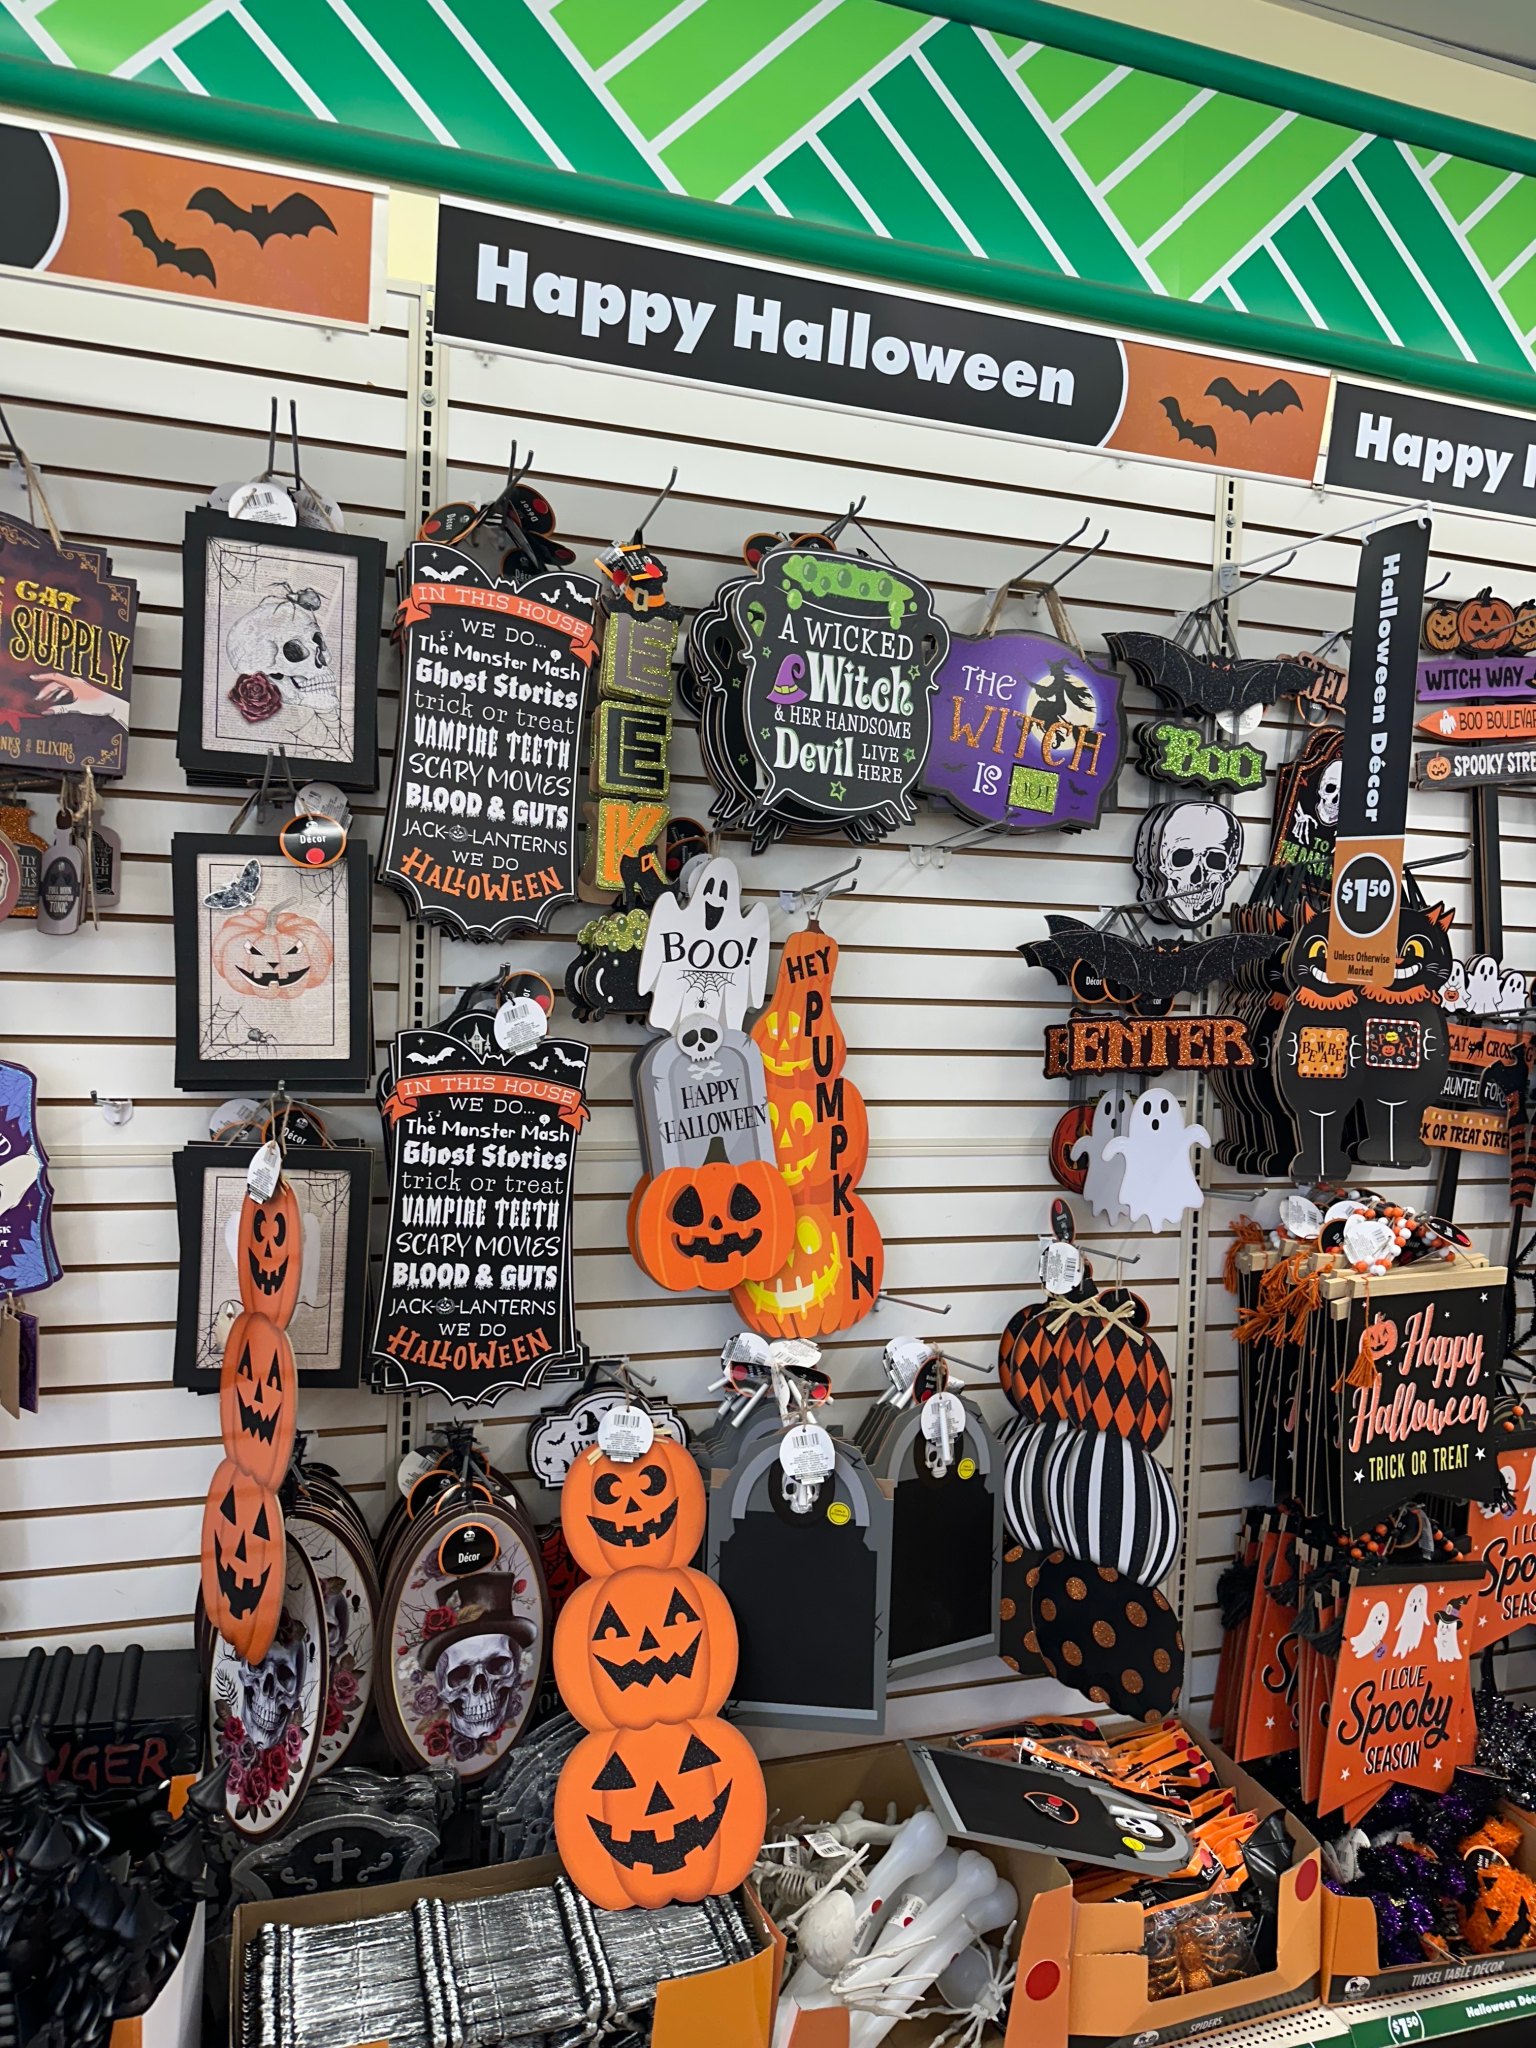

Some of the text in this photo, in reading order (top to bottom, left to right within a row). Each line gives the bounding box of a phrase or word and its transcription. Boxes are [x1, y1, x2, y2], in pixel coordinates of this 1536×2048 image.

[476, 243, 1076, 406] Happy Halloween
[1355, 412, 1514, 493] Happy
[515, 568, 533, 581] Déco
[418, 586, 588, 637] IN THIS HOUSE
[10, 604, 131, 691] SUPPLY
[461, 618, 546, 648] WE DO...
[778, 613, 914, 662] A WICKED
[419, 634, 581, 681] The Monster Mash
[415, 657, 578, 710] Ghost Stories
[806, 650, 914, 716] Witch
[961, 665, 1017, 700] THE
[1365, 553, 1400, 823] Halloween Décor
[1425, 666, 1524, 691] WITCH WAY
[414, 690, 575, 735] trick or treat
[774, 705, 912, 740] & HER HANDSOME
[1459, 712, 1482, 730] BOO
[414, 713, 570, 771] VAMPIRE TEETH
[773, 726, 855, 778] Devil
[949, 695, 1107, 777] WITCH
[861, 743, 900, 764] LIVE
[1454, 753, 1504, 777] SPOOKY
[409, 753, 572, 797] SCARY MOVIES
[857, 763, 903, 785] HERE
[973, 761, 1003, 796] IS
[405, 782, 569, 831] BLOOD & GUTS
[300, 834, 326, 844] Décor
[1313, 837, 1330, 852] TO
[400, 847, 564, 902] HALLOWEEN
[452, 850, 519, 871] WE DO
[660, 931, 758, 969] BOO!
[785, 946, 834, 984] HEY
[1334, 951, 1390, 964] Unless Otherwise
[1086, 976, 1102, 986] Décor
[1348, 965, 1373, 976] Marked
[1070, 1020, 1255, 1072] ENTER
[1302, 1041, 1344, 1063] BEWARE
[1449, 1034, 1468, 1052] CAT
[404, 1076, 576, 1105] IN THIS HOUSE
[680, 1077, 740, 1110] HAPPY
[1443, 1076, 1480, 1099] AUNTED
[449, 1097, 535, 1115] WE DO...
[406, 1117, 570, 1142] The Monster Mash
[664, 1105, 767, 1144] HALLOWEEN
[1433, 1124, 1447, 1141] OR
[1450, 1126, 1481, 1145] TREAT
[403, 1140, 568, 1171] Ghost Stories
[401, 1168, 564, 1195] trick or treat
[401, 1193, 560, 1232] VAMPIRE TEETH
[395, 1232, 561, 1258] SCARY MOVIES
[392, 1261, 558, 1292] BLOOD & GUTS
[439, 1323, 507, 1337] WE DO
[1399, 1302, 1485, 1388] Happy
[386, 1324, 552, 1371] HALLOWEEN
[1349, 1373, 1490, 1453] Halloween
[1369, 1444, 1470, 1482] TRICK OR TREAT
[1513, 1525, 1519, 1546] I
[458, 1552, 481, 1564] Décor
[1380, 1665, 1427, 1692] I LOVE
[1336, 1679, 1453, 1752] Spooky
[1364, 1740, 1421, 1775] SEASON
[1412, 1960, 1505, 1987] TINSEL TABLE DÉCOR
[1466, 1997, 1517, 2018] Halloween
[1189, 2016, 1223, 2033] SPIDERS
